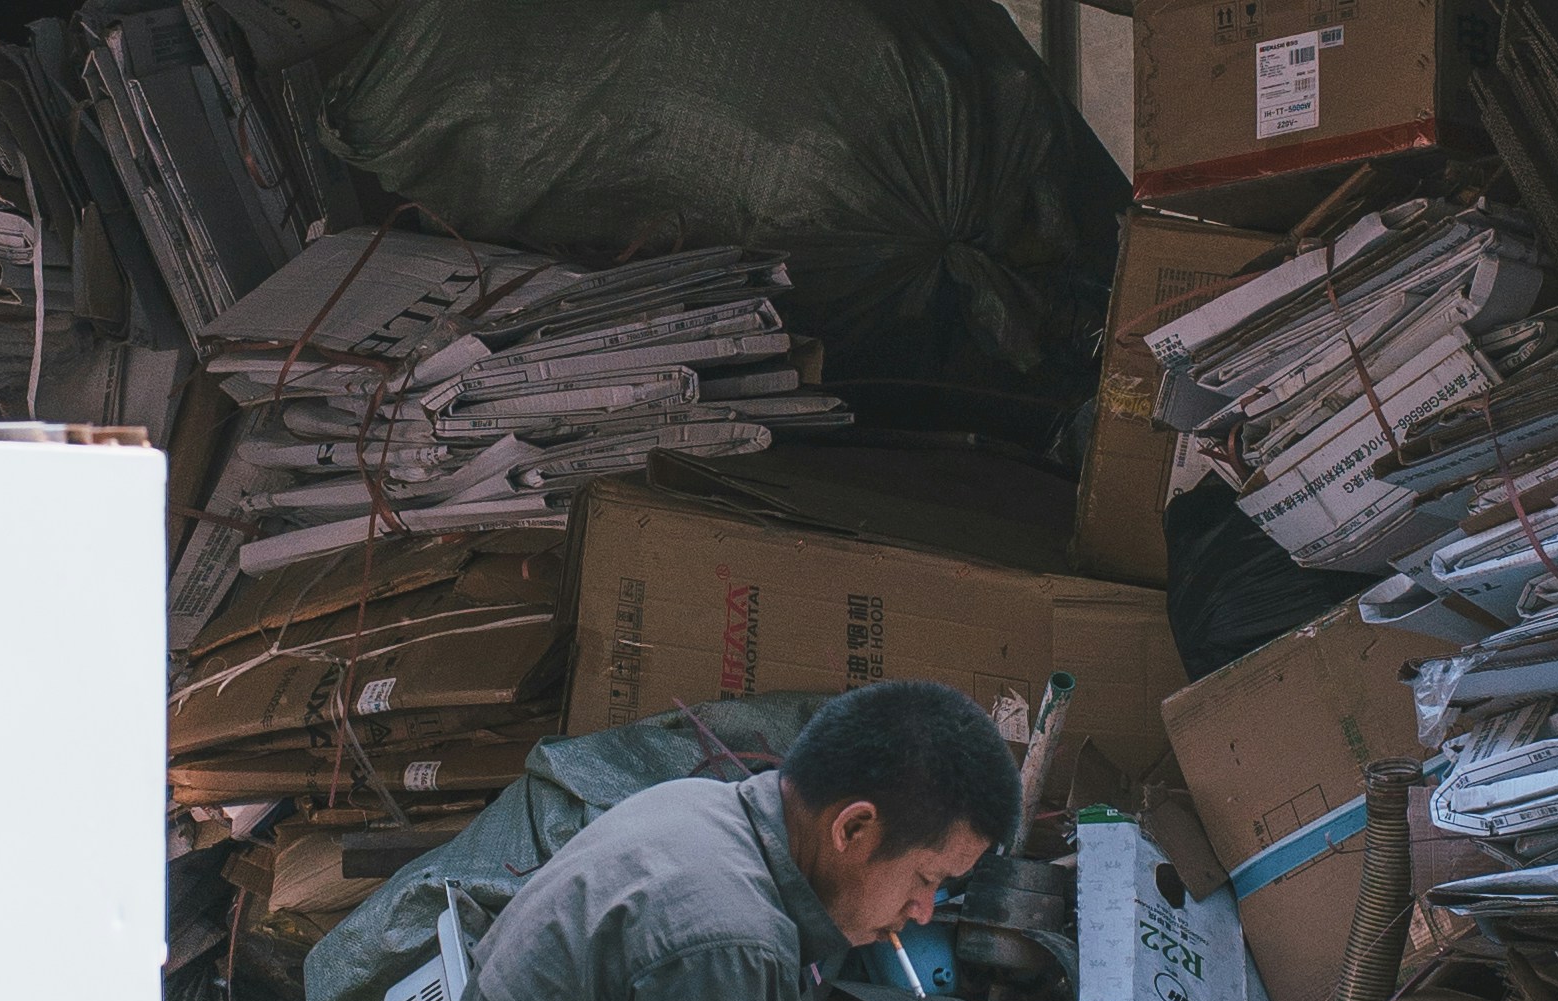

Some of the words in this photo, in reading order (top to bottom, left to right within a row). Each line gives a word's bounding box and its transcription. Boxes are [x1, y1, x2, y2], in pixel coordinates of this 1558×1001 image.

[354, 266, 491, 357] TILE
[870, 596, 884, 649] HOOD
[1139, 920, 1205, 982] R22
